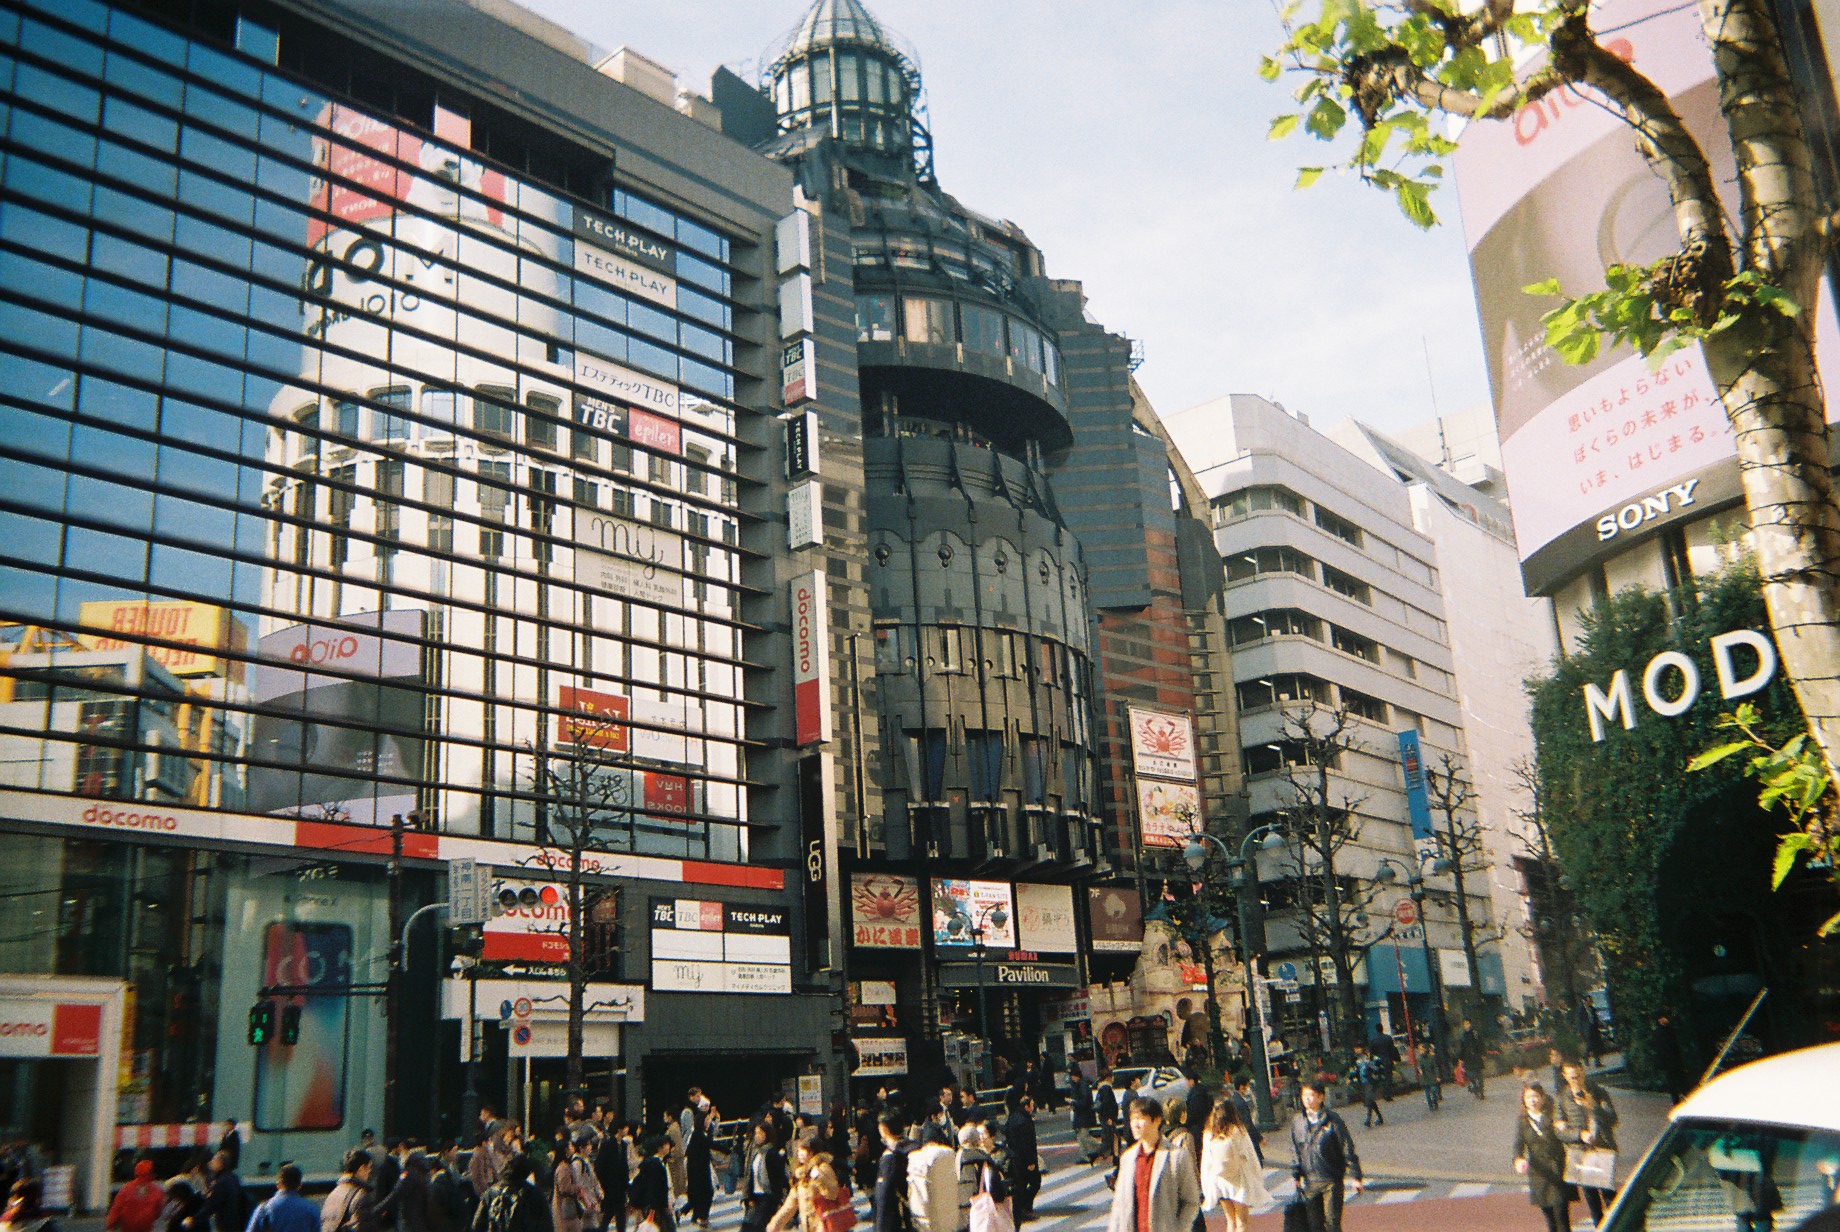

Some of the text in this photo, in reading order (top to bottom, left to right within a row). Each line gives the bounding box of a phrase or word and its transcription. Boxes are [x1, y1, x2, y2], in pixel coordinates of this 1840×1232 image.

[583, 215, 625, 244] TECH
[628, 235, 668, 261] PLAY
[584, 253, 668, 295] TECH PLAY
[579, 364, 675, 408] エステティックTBC
[1567, 359, 1692, 433] 思いもよらない
[580, 404, 622, 435] TBC
[634, 423, 675, 447] epiler
[1596, 478, 1700, 542] SONY
[797, 587, 811, 673] docomo
[82, 806, 177, 831] docomo
[808, 840, 822, 882] UGG
[654, 910, 675, 922] TBC
[679, 911, 698, 922] TBC
[731, 912, 782, 924] TECH PLAY
[998, 965, 1050, 983] Pavilion
